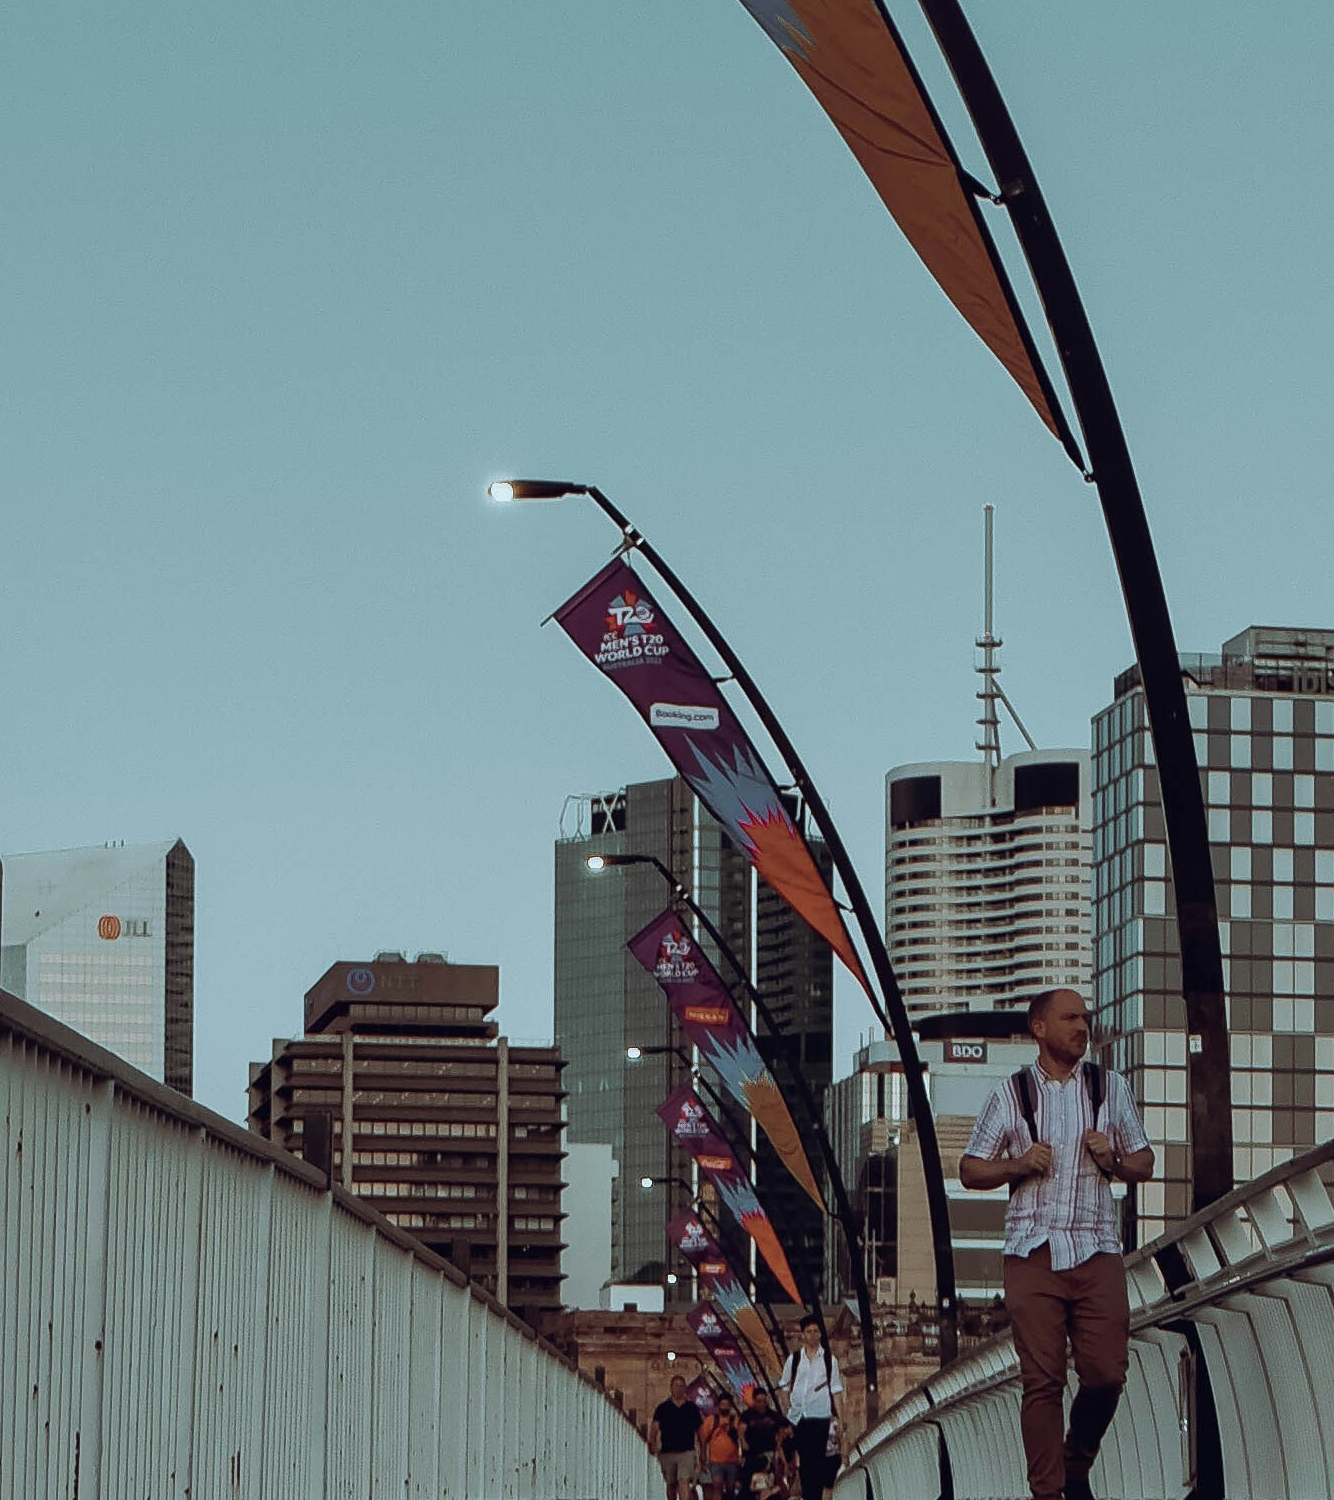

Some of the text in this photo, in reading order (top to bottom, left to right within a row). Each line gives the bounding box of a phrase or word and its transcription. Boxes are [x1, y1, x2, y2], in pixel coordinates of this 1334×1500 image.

[600, 634, 664, 652] MEN'S T20
[595, 645, 669, 664] WORLD CUP
[655, 709, 715, 722] Booking.com
[953, 1045, 983, 1058] BDO
